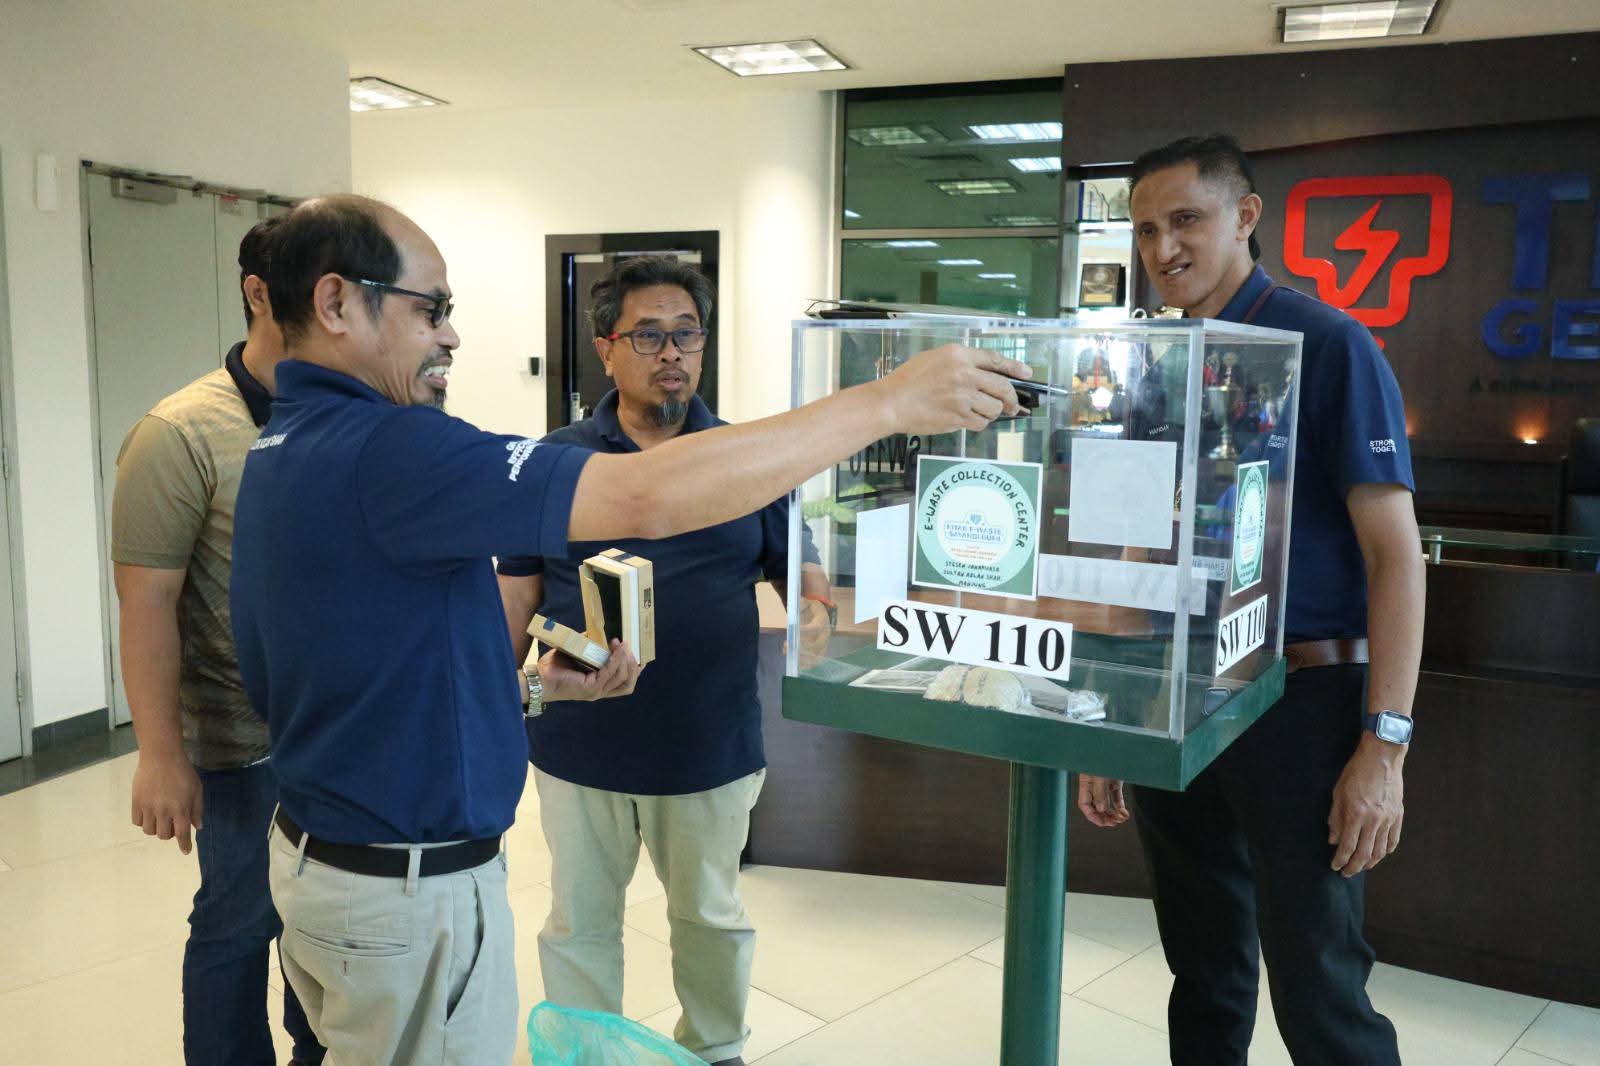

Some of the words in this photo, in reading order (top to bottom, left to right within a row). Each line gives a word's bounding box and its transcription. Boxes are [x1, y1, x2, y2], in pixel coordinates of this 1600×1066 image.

[924, 480, 950, 531] E-WASTE
[951, 469, 1018, 500] COLLECTION
[1015, 501, 1029, 548] CENTER
[883, 605, 967, 655] SW
[984, 620, 1065, 672] 110
[1218, 613, 1243, 666] SW
[1247, 601, 1266, 648] 110
